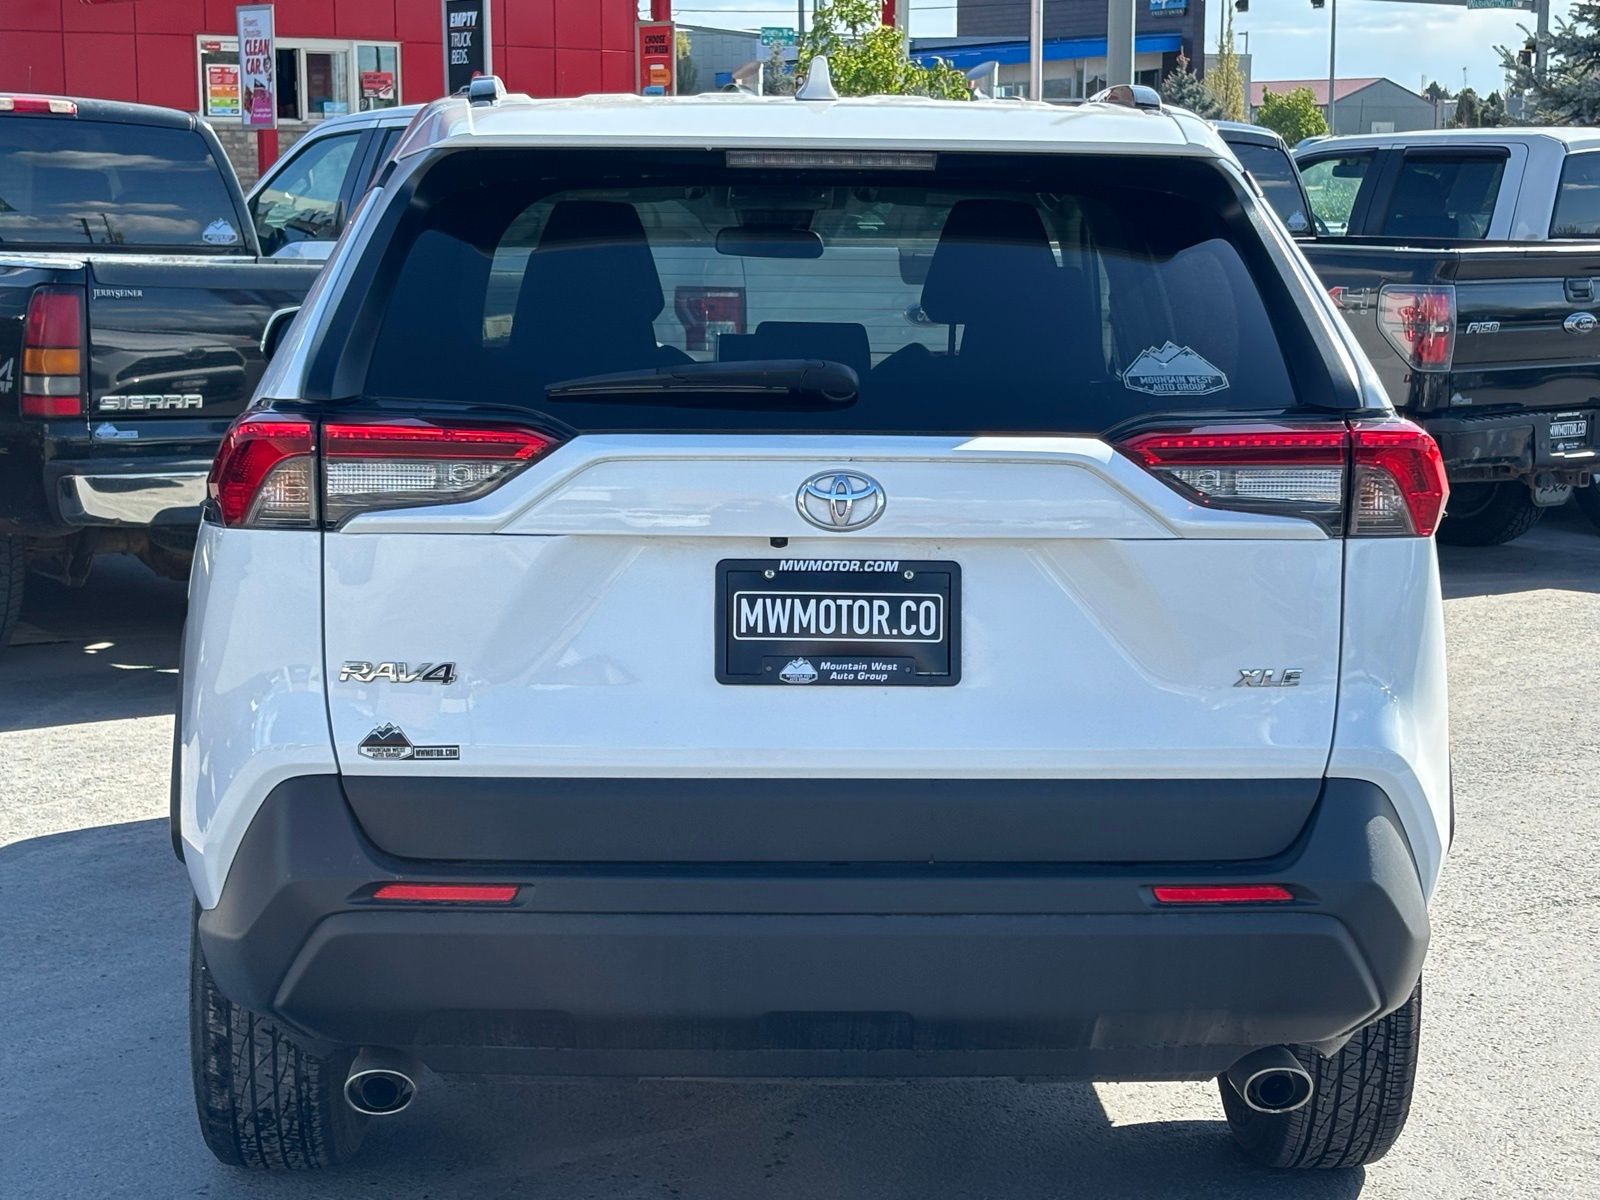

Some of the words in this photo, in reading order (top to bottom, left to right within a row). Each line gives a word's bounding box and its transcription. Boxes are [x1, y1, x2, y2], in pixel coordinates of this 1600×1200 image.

[450, 11, 478, 27] EMPTY
[245, 39, 271, 56] CLEAN
[450, 32, 472, 47] TRUCK
[451, 49, 469, 65] BEDS.
[246, 58, 264, 75] CAR.
[1139, 376, 1187, 384] MOUNTAIN
[1187, 376, 1213, 384] WEST
[1153, 383, 1175, 392] AUTO
[1176, 383, 1207, 391] GROUP
[99, 394, 203, 411] SIERRA
[778, 560, 900, 572] MWMOTOR.COM
[740, 598, 936, 636] MWMOTOR.CO
[338, 660, 458, 686] RAV4
[820, 661, 869, 671] Mountain
[871, 662, 898, 671] West
[830, 671, 855, 680] Auto
[857, 672, 888, 682] Group
[1232, 668, 1305, 687] XLE
